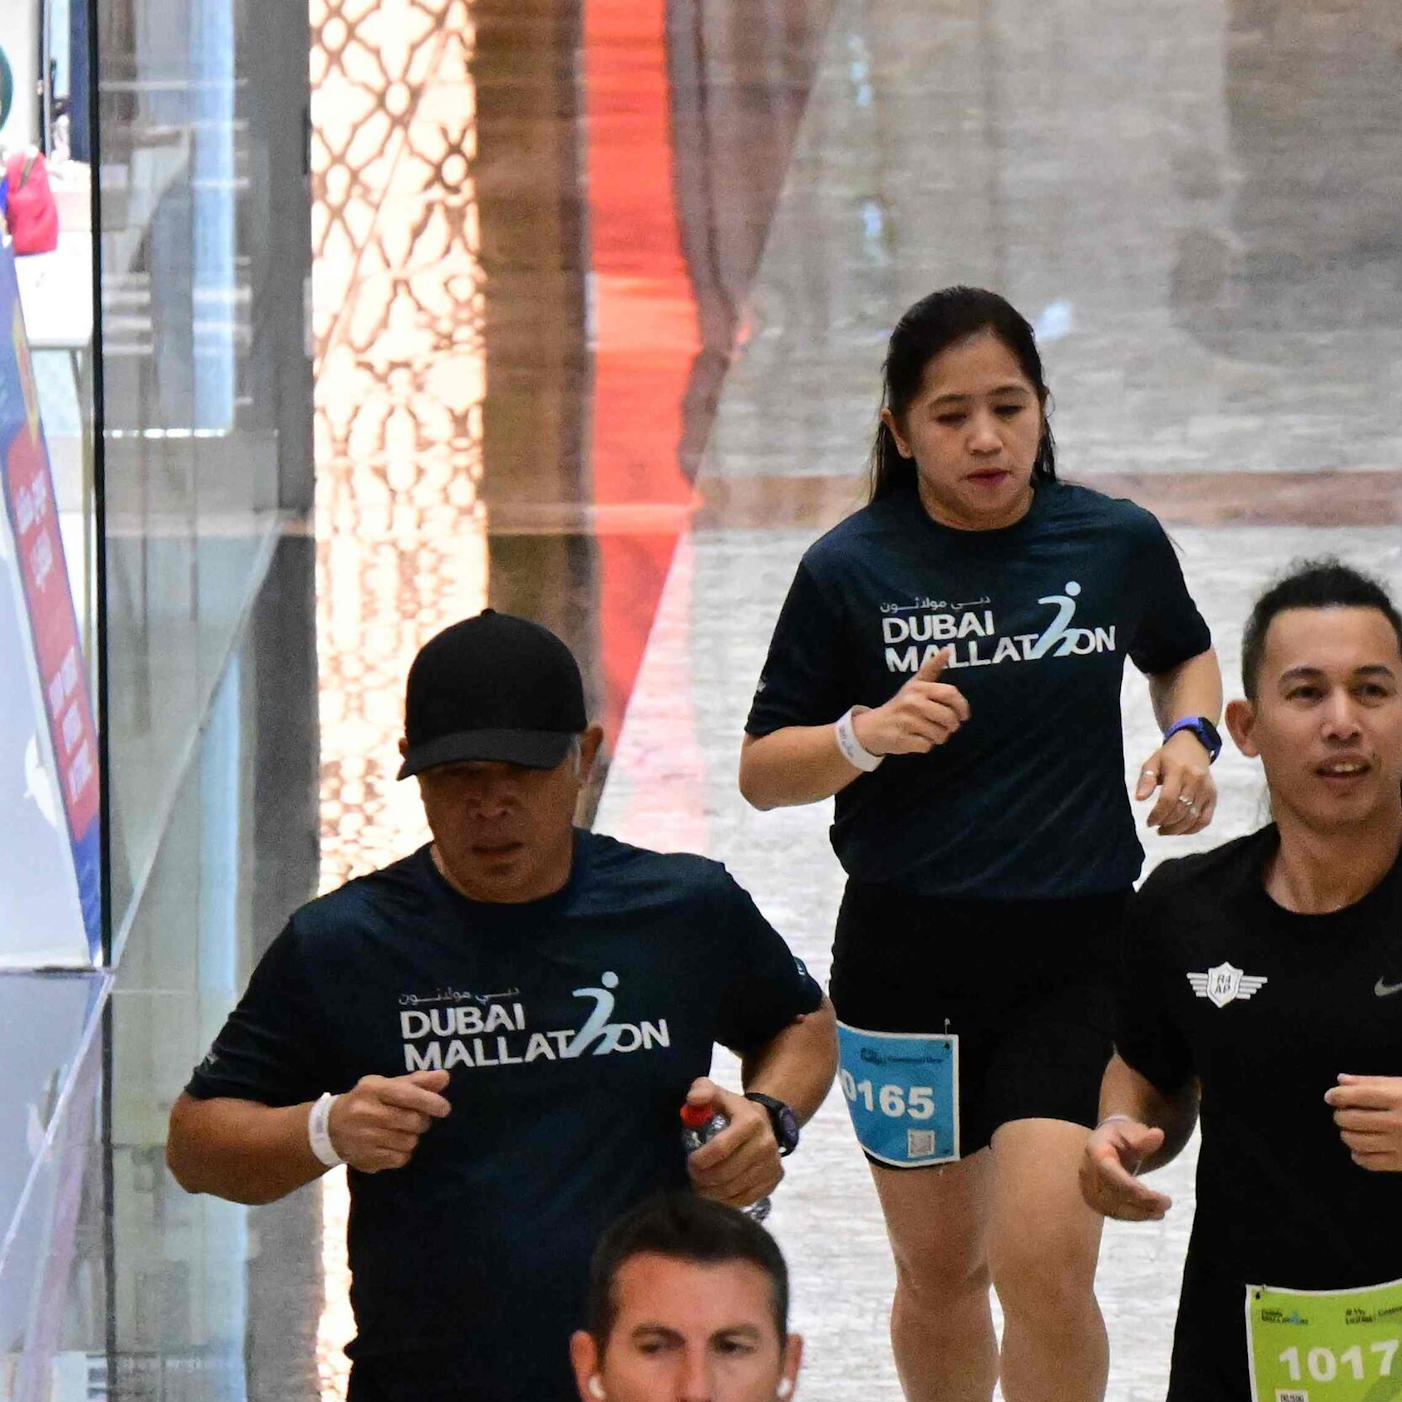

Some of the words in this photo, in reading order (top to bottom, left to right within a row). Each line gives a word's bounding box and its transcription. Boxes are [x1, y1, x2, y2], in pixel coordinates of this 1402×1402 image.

[882, 610, 995, 644] DUBAI
[400, 1003, 526, 1039] DUBAI
[840, 1069, 935, 1120] 0165
